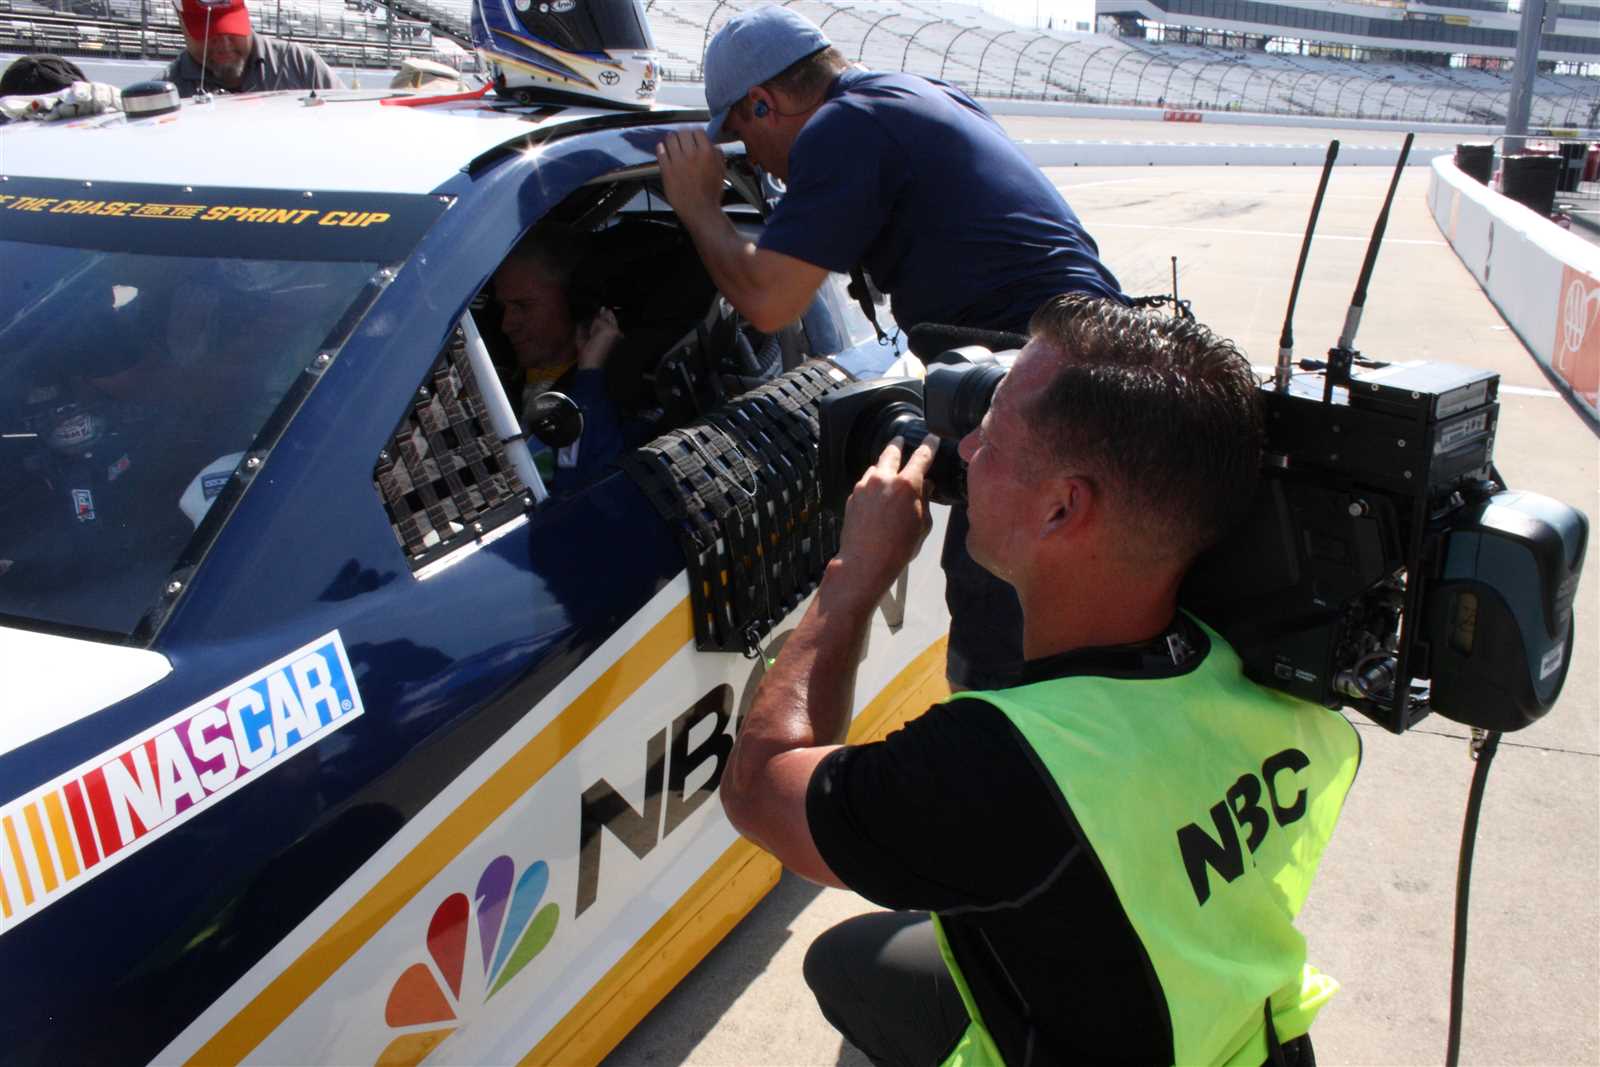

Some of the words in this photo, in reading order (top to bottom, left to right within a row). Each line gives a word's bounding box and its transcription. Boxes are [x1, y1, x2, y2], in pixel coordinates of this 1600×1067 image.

[6, 196, 59, 211] THE
[49, 199, 140, 216] CHASE
[200, 206, 319, 224] SPRINT
[318, 211, 391, 228] CUP
[102, 652, 343, 846] NASCAR
[1176, 748, 1310, 907] NBC
